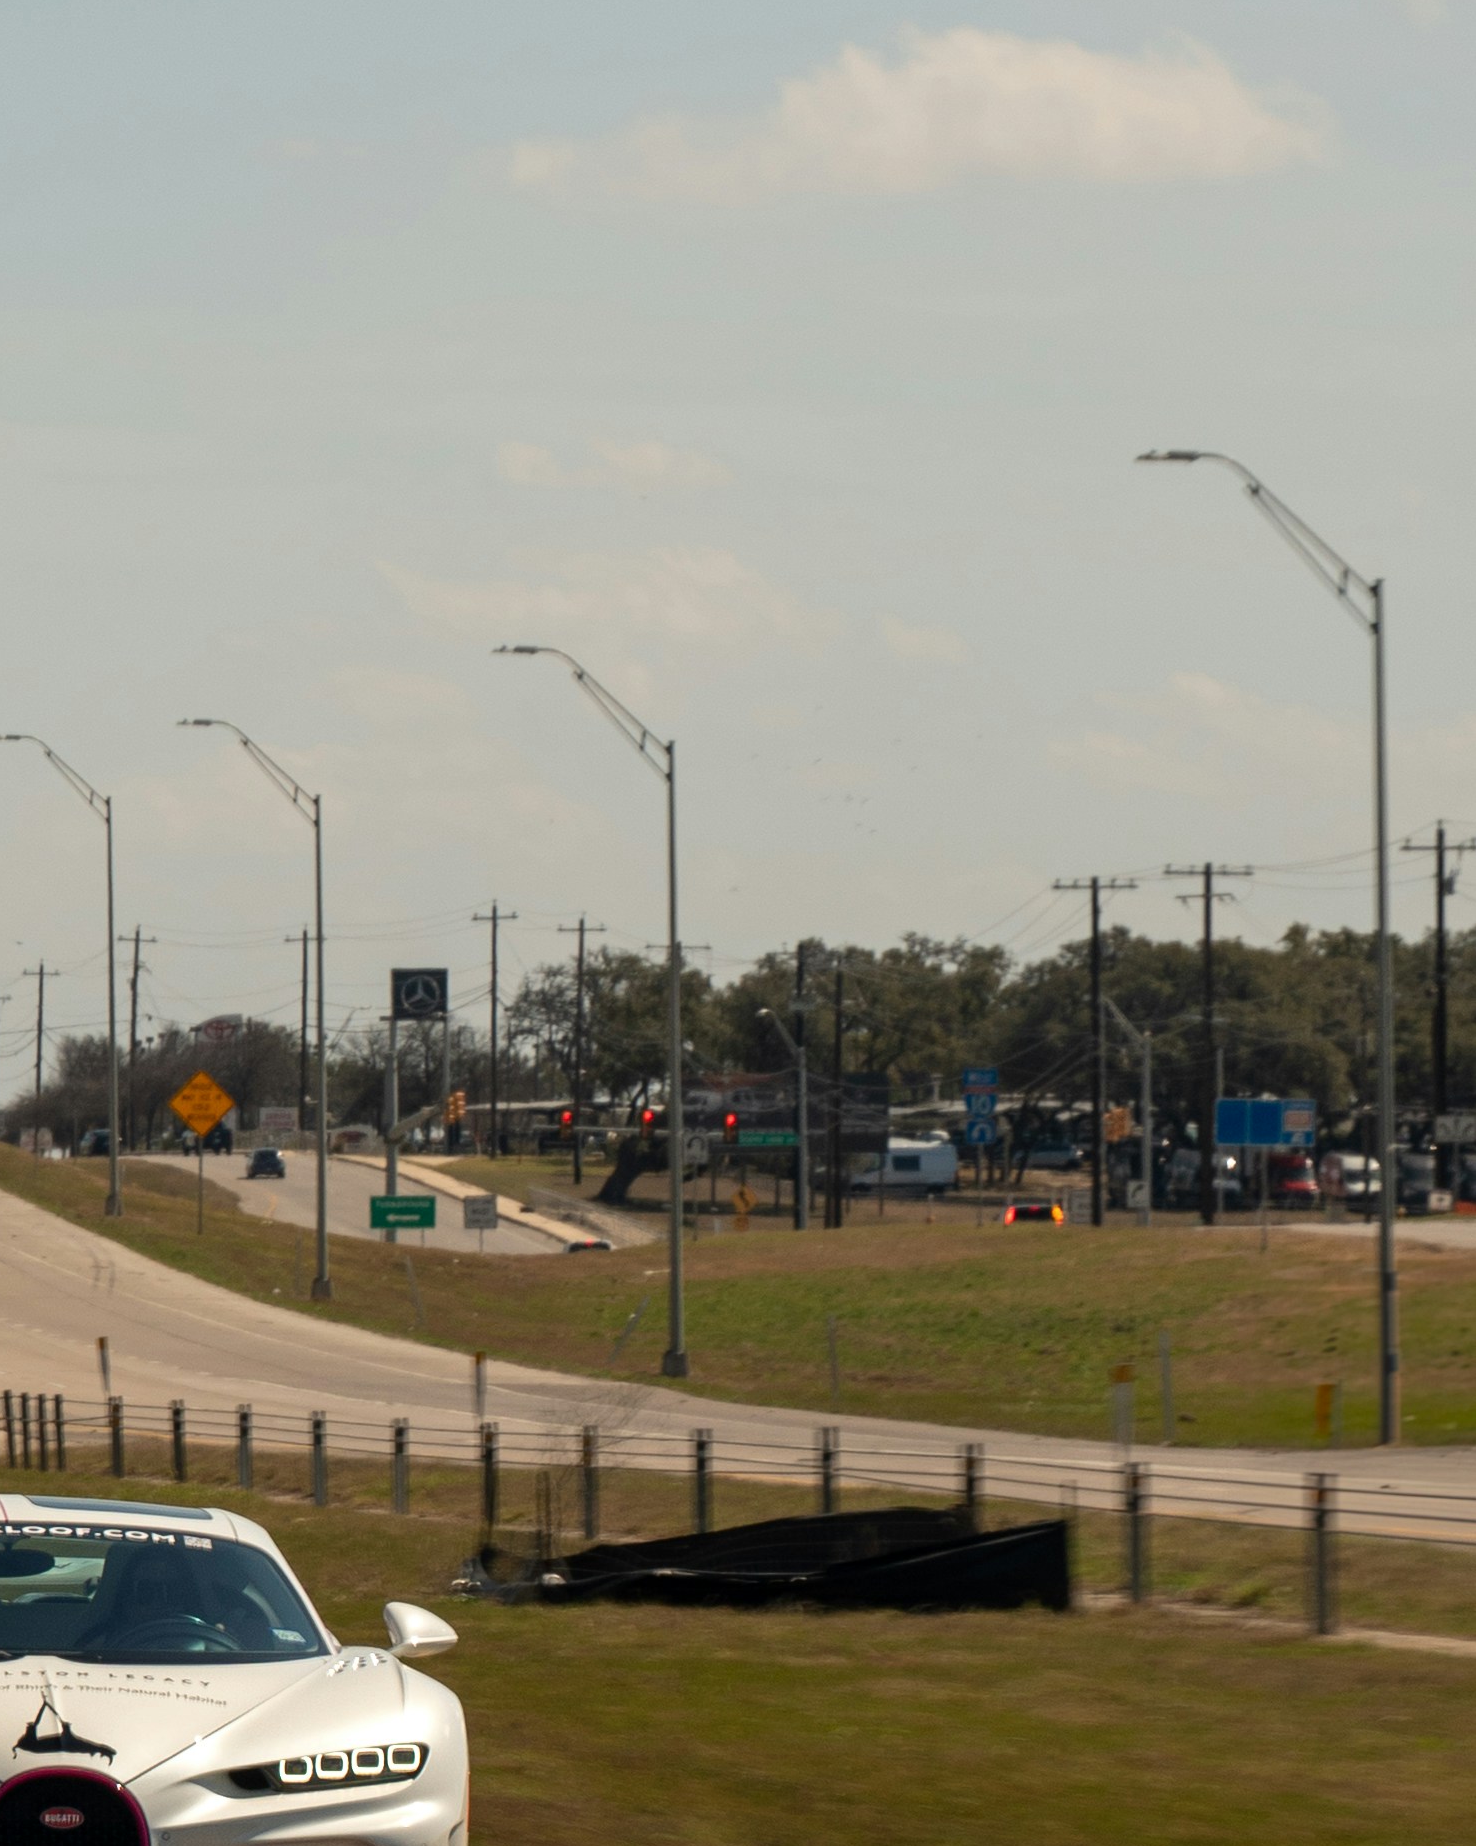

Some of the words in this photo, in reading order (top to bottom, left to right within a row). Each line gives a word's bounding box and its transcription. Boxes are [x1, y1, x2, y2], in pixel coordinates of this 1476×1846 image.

[109, 1672, 210, 1687] LEGACY
[78, 1684, 113, 1693] Their
[118, 1686, 171, 1698] Natural
[175, 1692, 227, 1706] Habitat
[44, 1813, 80, 1823] BUGATTI
